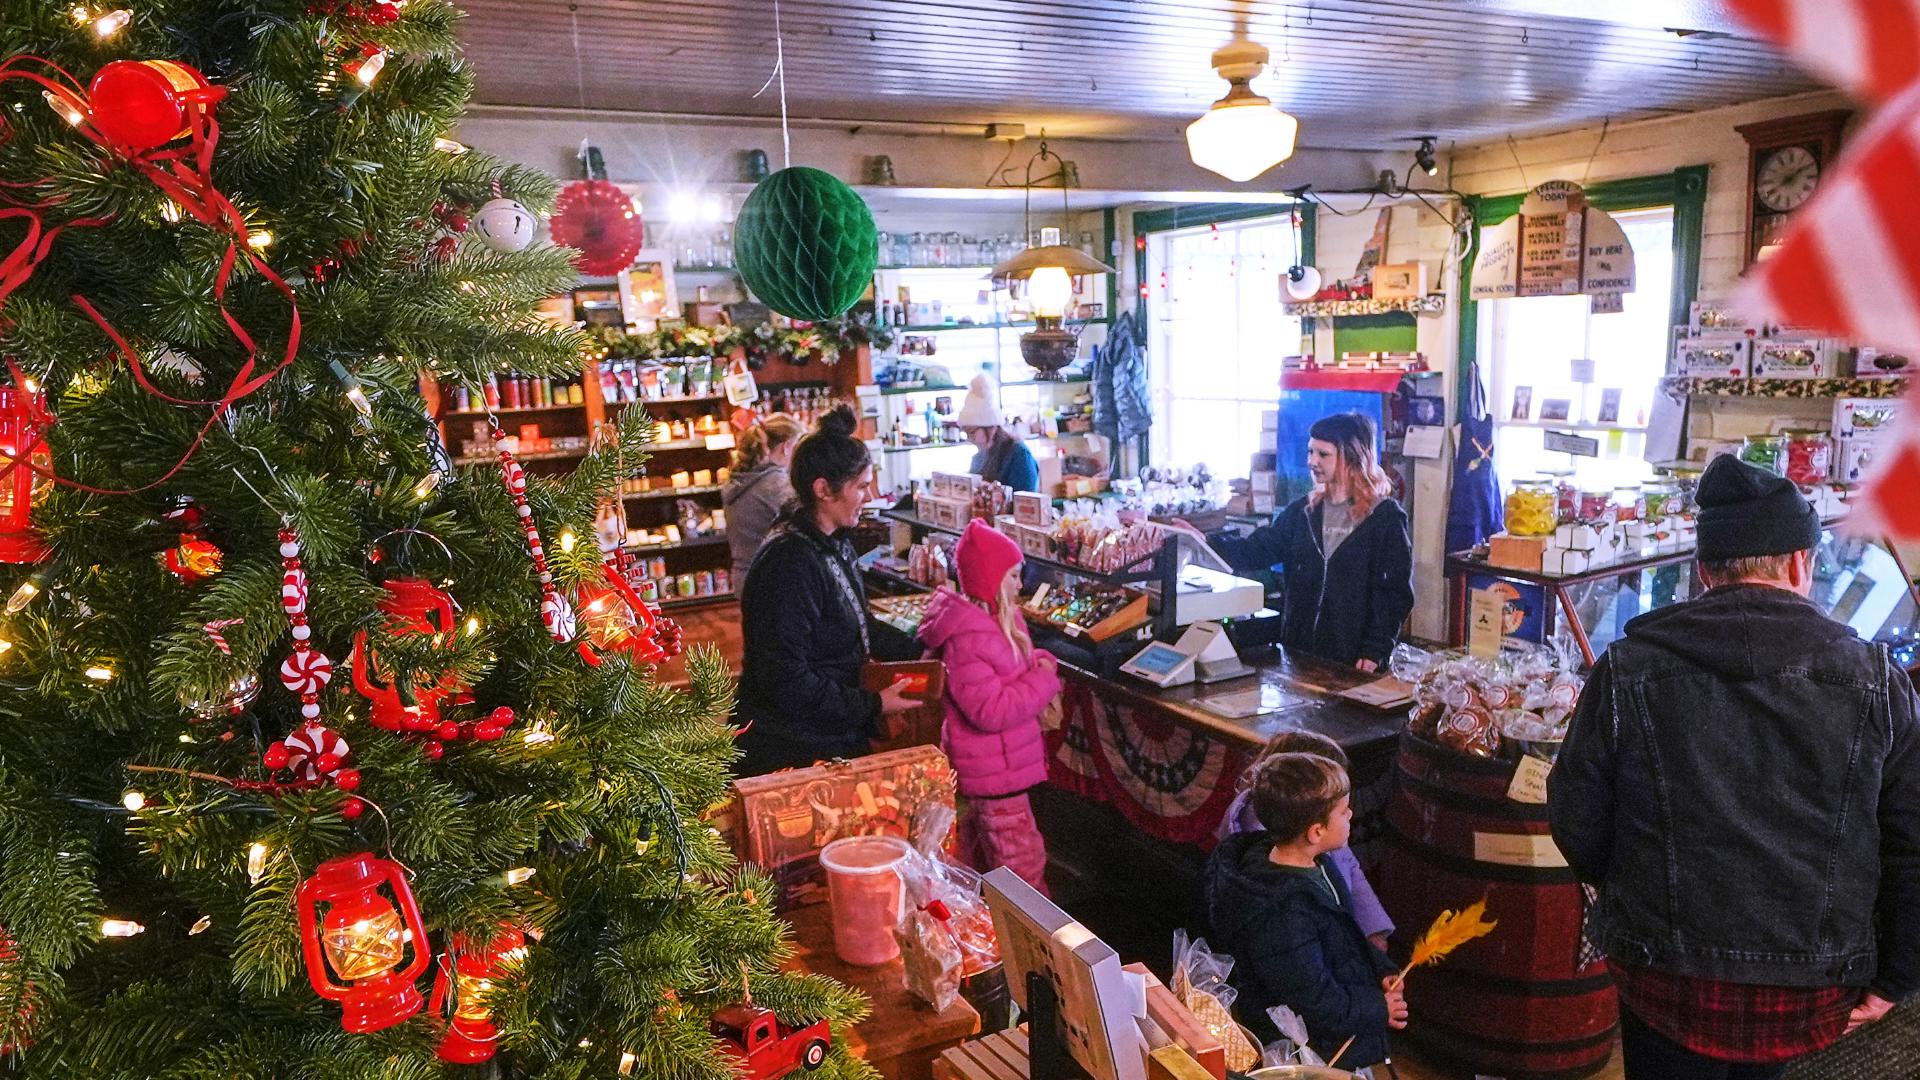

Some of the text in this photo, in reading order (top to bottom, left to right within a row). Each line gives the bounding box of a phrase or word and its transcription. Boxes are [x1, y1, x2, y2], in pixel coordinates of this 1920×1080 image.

[1535, 181, 1570, 196] SPECIAL
[1540, 193, 1567, 201] TODAY
[1589, 245, 1623, 256] BUY HERE
[1587, 279, 1631, 289] CONFIDENCE
